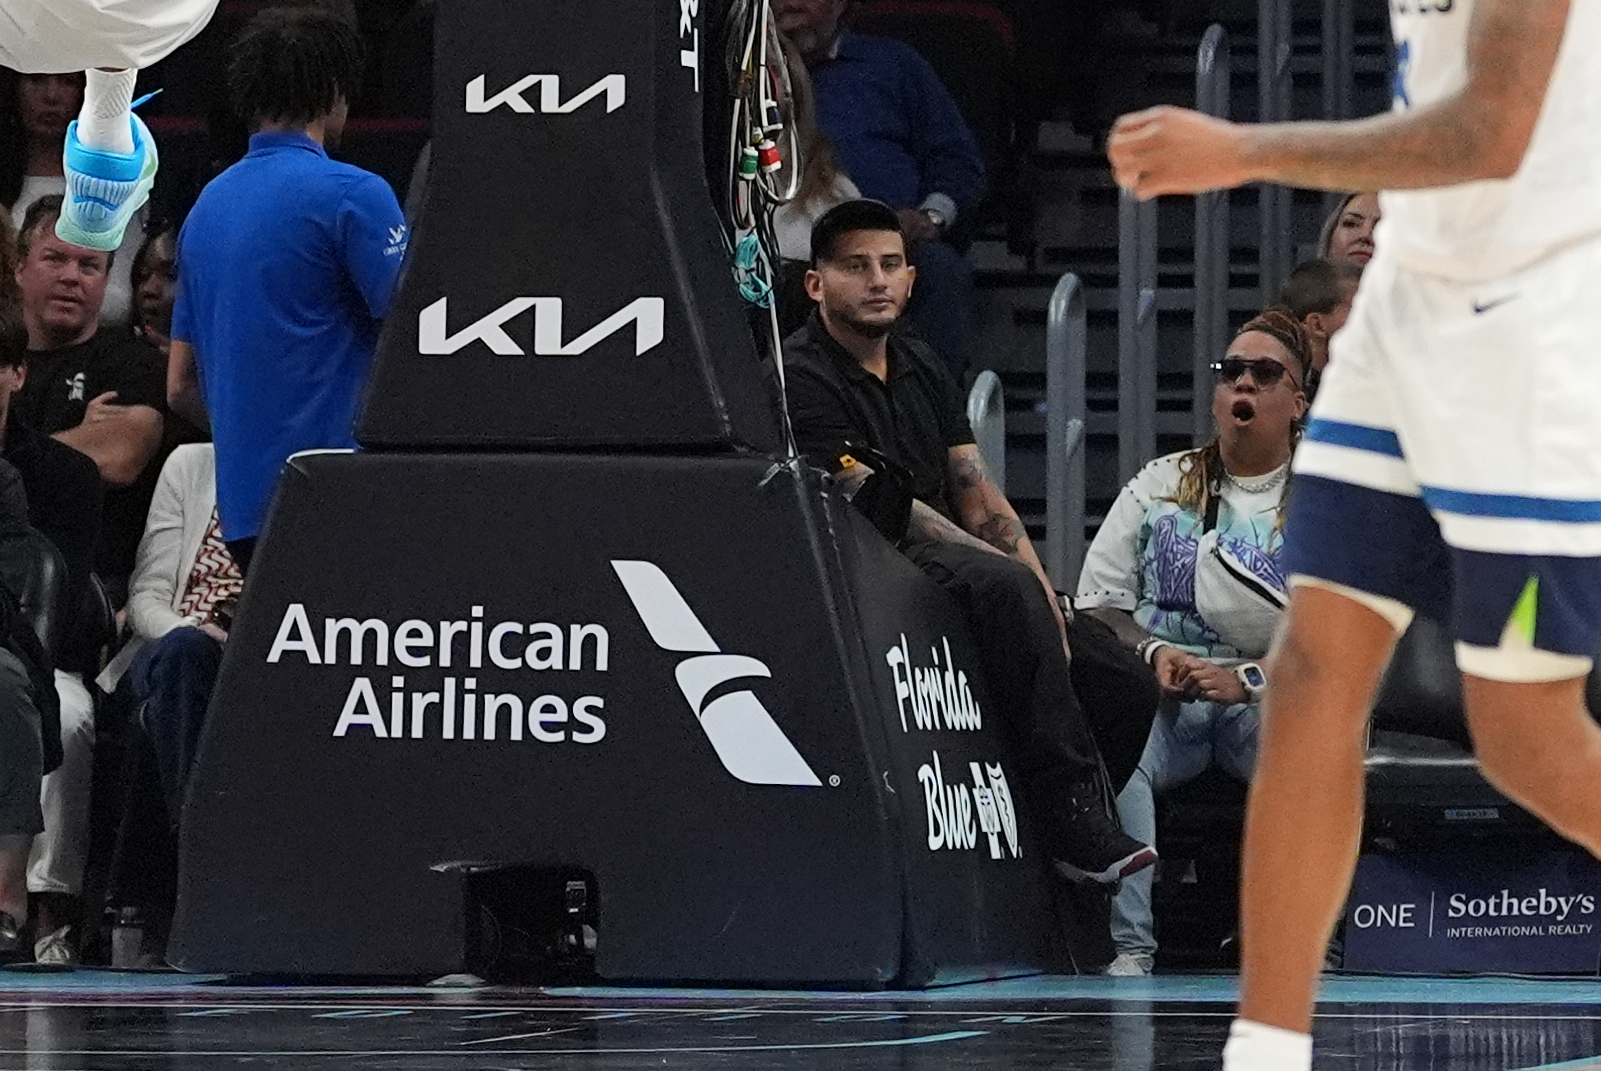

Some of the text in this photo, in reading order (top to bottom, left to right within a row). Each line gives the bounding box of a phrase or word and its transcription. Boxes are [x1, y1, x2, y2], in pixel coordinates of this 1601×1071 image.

[465, 74, 625, 113] KIA
[418, 296, 664, 356] KIA
[266, 603, 610, 671] American
[332, 676, 607, 743] Airlines
[886, 633, 982, 733] Florida
[917, 750, 976, 851] Blue
[1353, 888, 1596, 928] ONE Sotheby's
[1447, 924, 1593, 938] INTERNATIONAL REALTY
